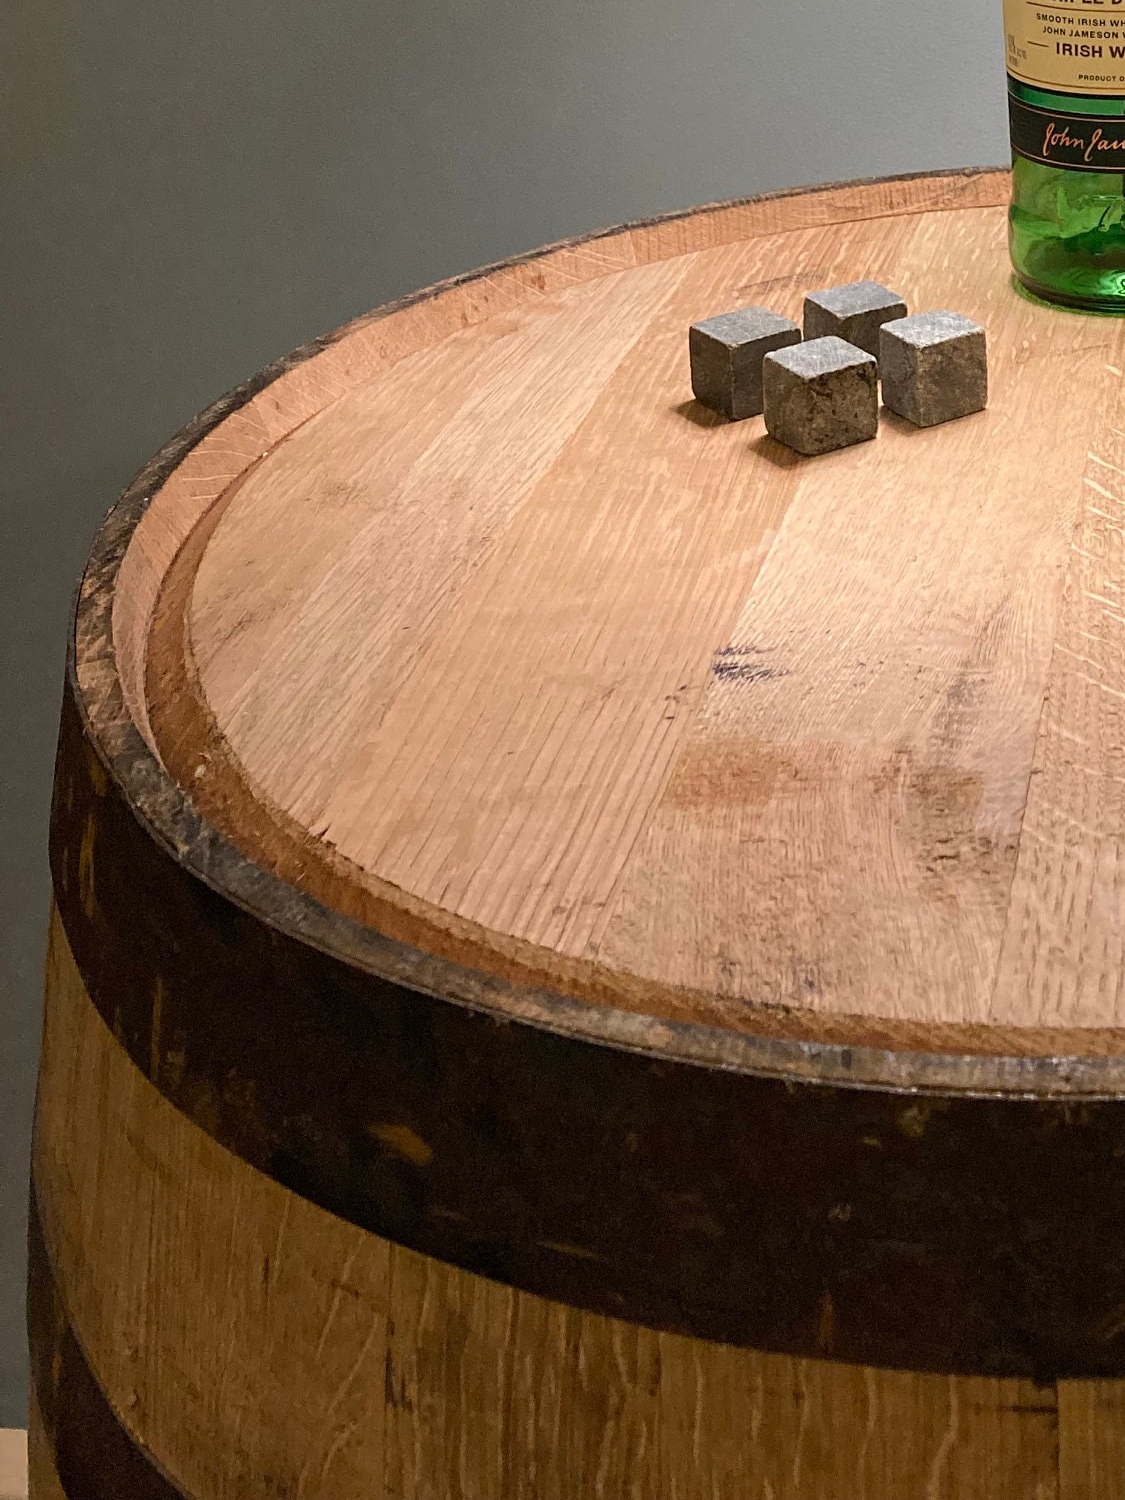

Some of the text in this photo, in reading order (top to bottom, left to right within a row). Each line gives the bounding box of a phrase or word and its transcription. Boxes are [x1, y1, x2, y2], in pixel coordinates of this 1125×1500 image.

[1036, 12, 1074, 25] SMOOTH
[1077, 18, 1106, 27] IRISH
[1042, 26, 1066, 36] JOHN
[1069, 30, 1119, 39] JAMESON
[1056, 41, 1103, 58] IRISH
[1078, 74, 1116, 82] PRODUCT
[1042, 122, 1085, 156] John
